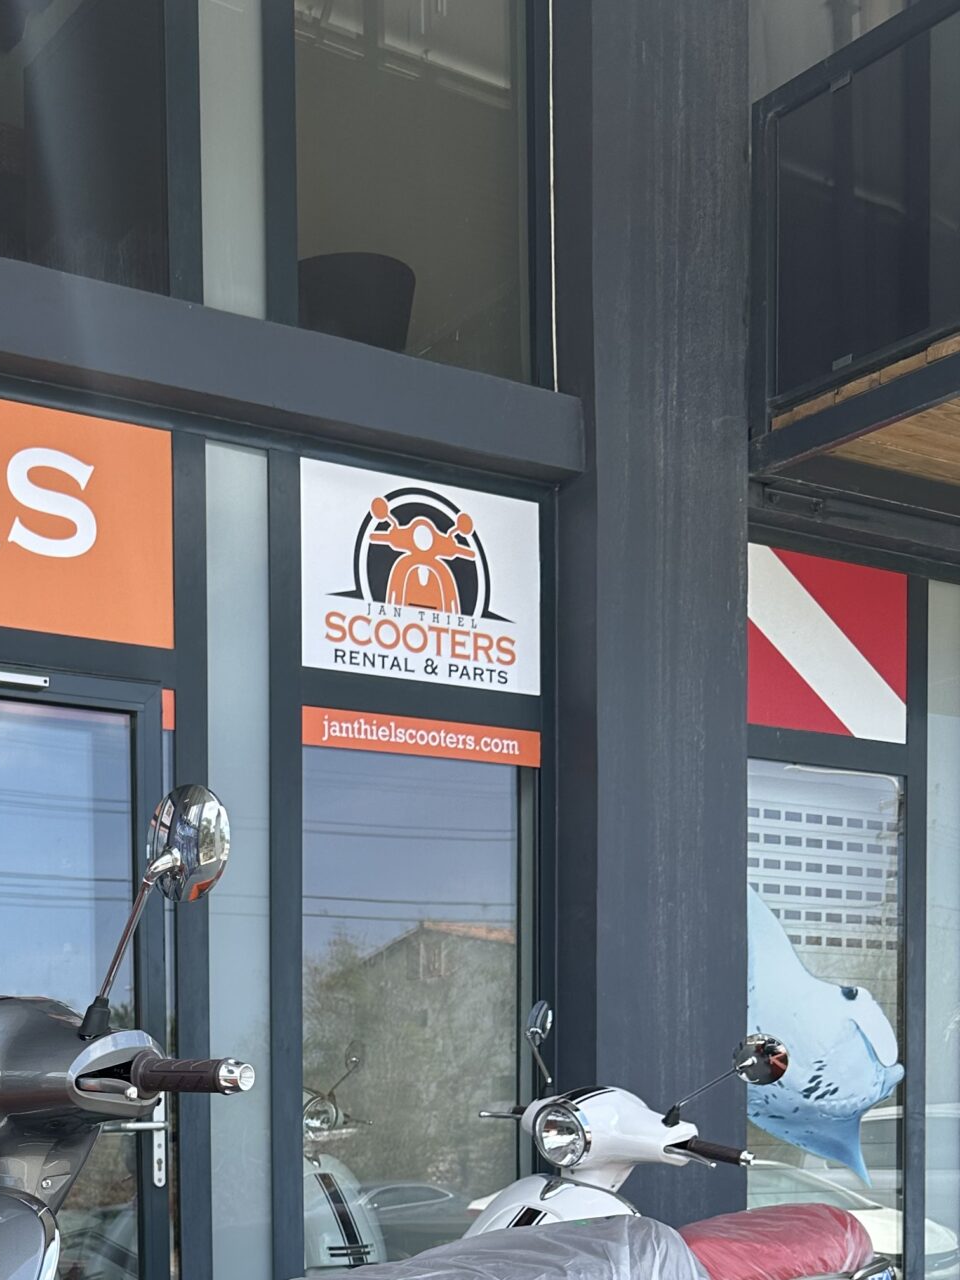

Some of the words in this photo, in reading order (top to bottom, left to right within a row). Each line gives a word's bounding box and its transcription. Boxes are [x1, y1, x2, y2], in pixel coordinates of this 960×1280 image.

[367, 603, 402, 618] JAN
[418, 610, 478, 629] THIEL
[324, 611, 516, 666] SCOOTERS
[334, 648, 415, 674] RENTAL
[424, 657, 438, 676] &
[448, 663, 508, 685] PARTS
[322, 715, 520, 755] janthielscooters.com
